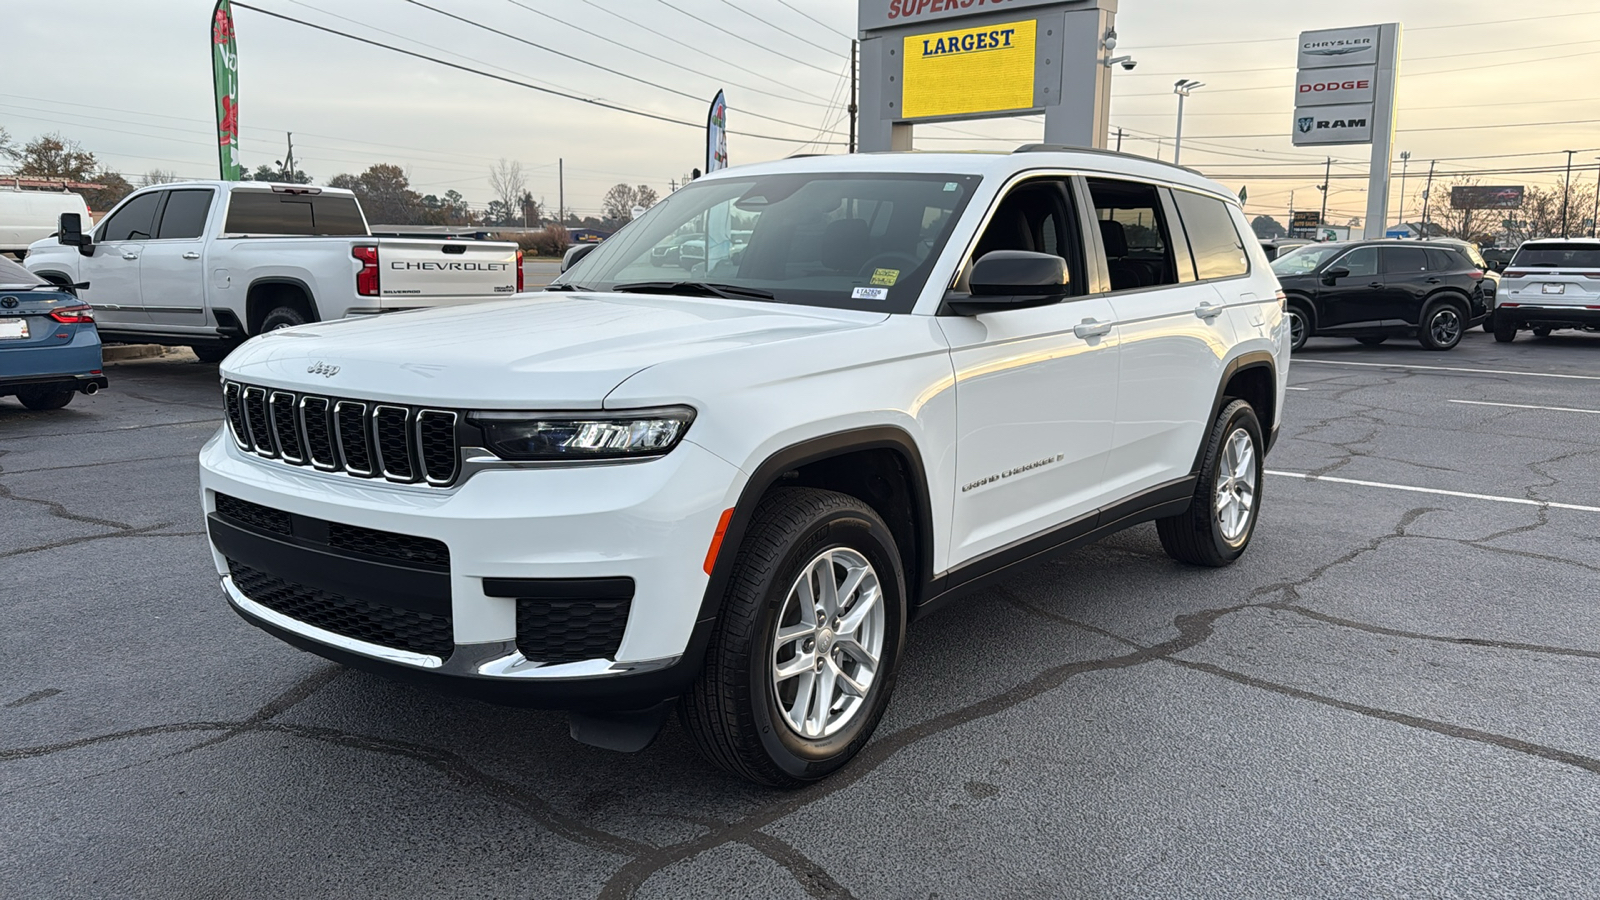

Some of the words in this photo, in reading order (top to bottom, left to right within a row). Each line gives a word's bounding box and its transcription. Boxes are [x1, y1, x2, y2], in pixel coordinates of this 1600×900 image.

[888, 0, 1013, 19] SUPER
[922, 29, 1015, 56] LARGEST
[1303, 38, 1371, 49] CHRYSLER
[1299, 80, 1369, 93] DODGE
[1316, 119, 1367, 129] RAM
[391, 262, 510, 271] CHEVROLET
[307, 360, 341, 378] Jeep
[962, 474, 1000, 493] GRAND
[1001, 456, 1055, 479] CHEROKEE
